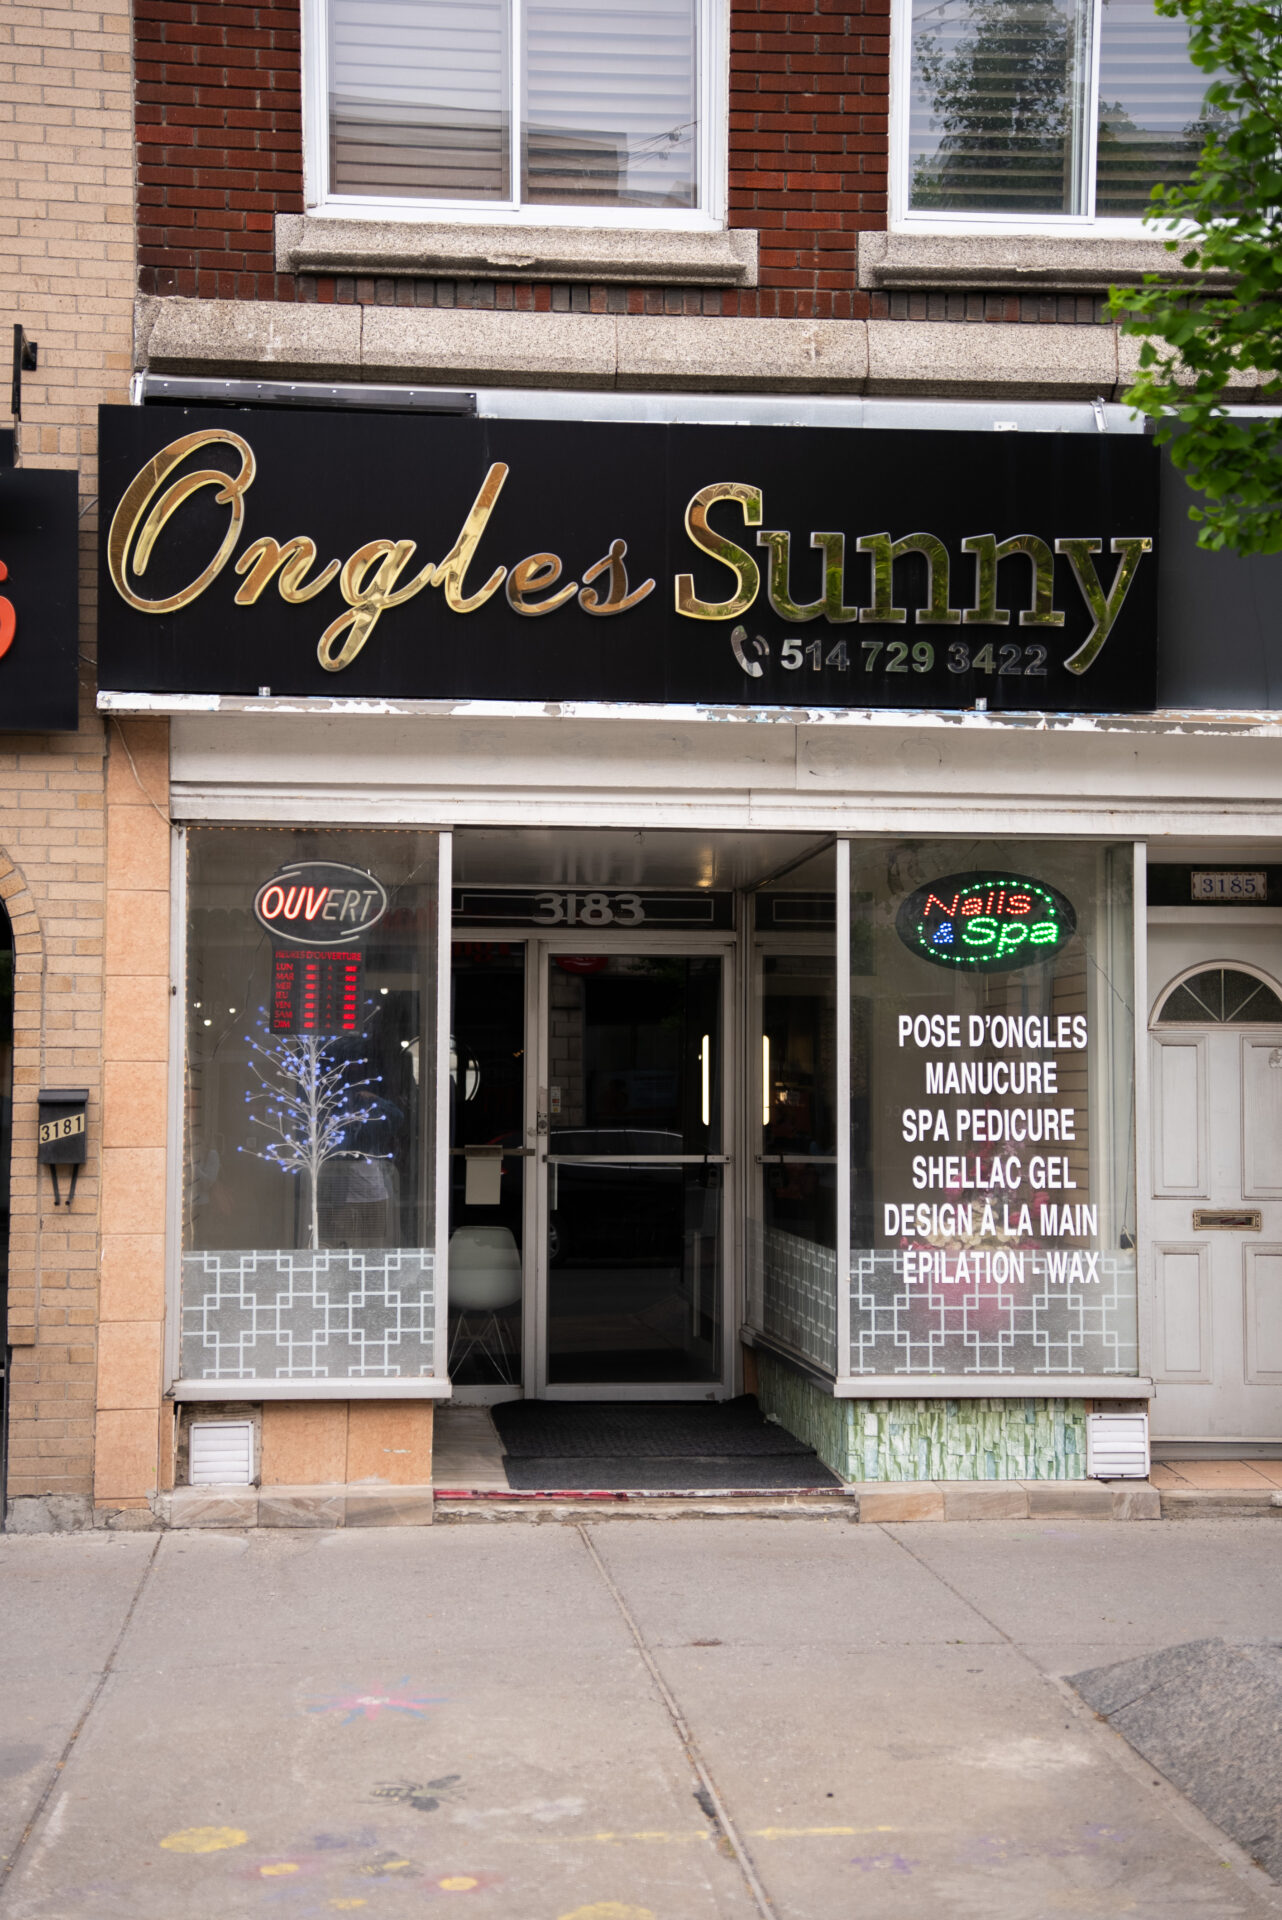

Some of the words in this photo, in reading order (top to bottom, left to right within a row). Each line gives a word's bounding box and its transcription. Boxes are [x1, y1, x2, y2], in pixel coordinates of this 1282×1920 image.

[108, 428, 656, 672] Ongles
[675, 482, 1153, 676] Sunny
[780, 639, 850, 672] 514
[861, 641, 935, 673] 729
[947, 641, 1048, 675] 3422
[1202, 878, 1256, 894] 3185
[261, 885, 378, 922] OUVERT
[531, 892, 646, 926] 3183
[923, 890, 1032, 917] Nails
[932, 922, 954, 944] &
[961, 916, 1059, 951] Spa
[276, 963, 294, 972] LUN
[276, 973, 295, 981] MAR
[274, 1010, 293, 1018] SAM
[275, 1001, 292, 1009] VEN
[273, 1020, 291, 1028] DIM
[898, 1015, 961, 1048] POSE
[969, 1015, 1088, 1049] D'ONGLES
[925, 1062, 1058, 1095] MANUCURE
[41, 1115, 81, 1142] 3181
[902, 1108, 950, 1142] SPA
[956, 1108, 1076, 1142] PEDICURE
[912, 1155, 1021, 1189] SHELLAC
[1029, 1156, 1077, 1189] GEL
[884, 1203, 972, 1236] DESIGN
[980, 1198, 996, 1236] À
[1003, 1204, 1033, 1236] LA
[1040, 1204, 1098, 1236] MAIN
[903, 1246, 1025, 1284] ÉPILATION
[1047, 1252, 1100, 1284] WAX
